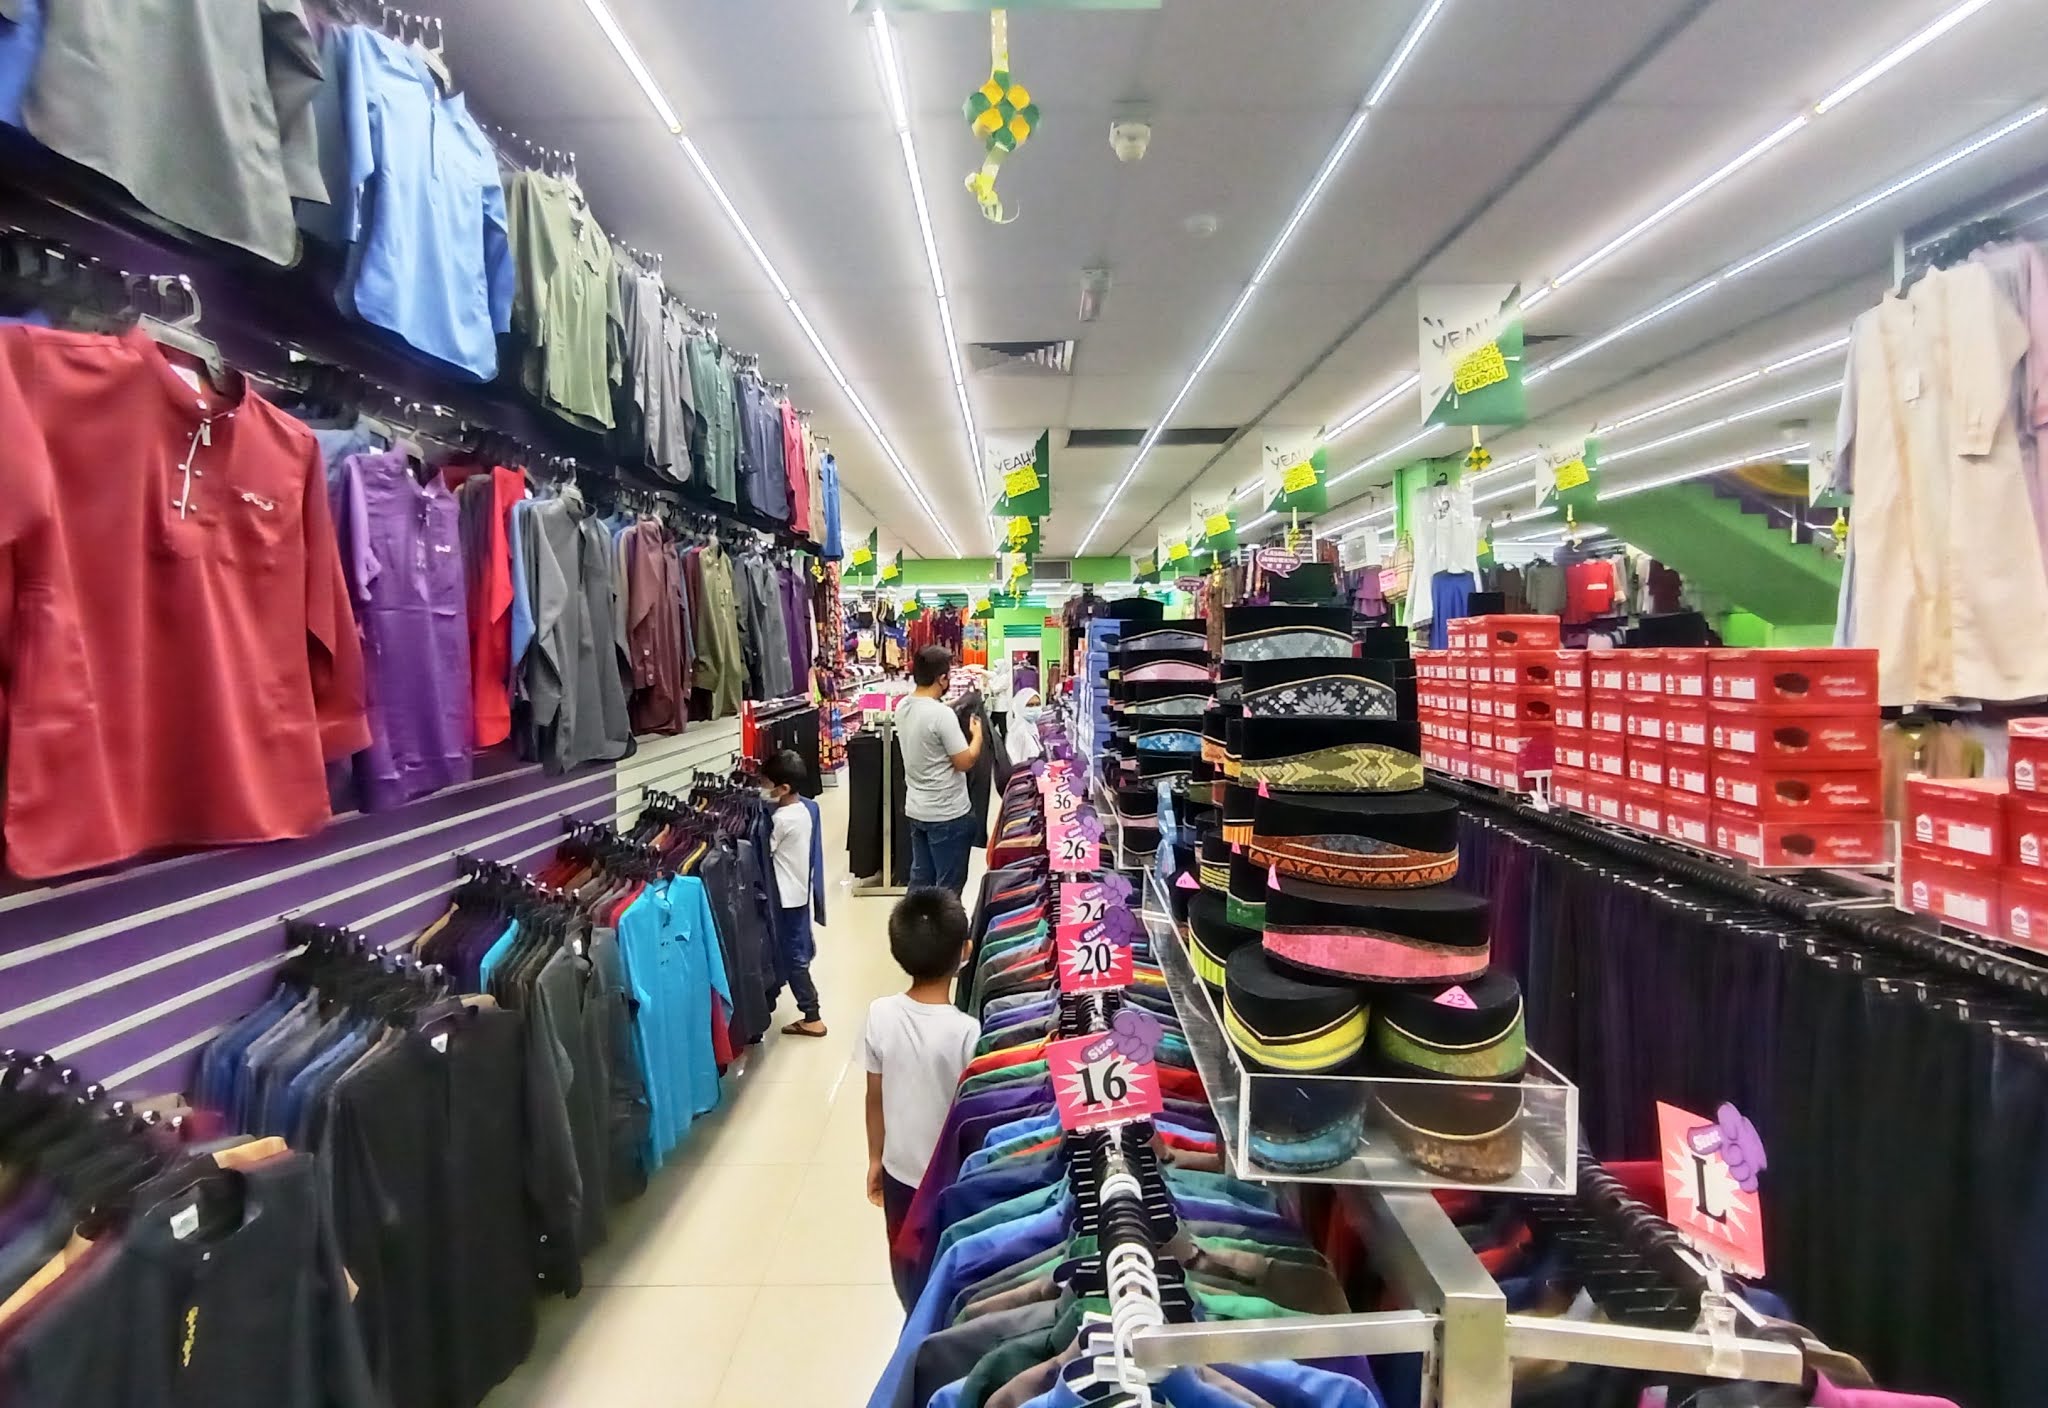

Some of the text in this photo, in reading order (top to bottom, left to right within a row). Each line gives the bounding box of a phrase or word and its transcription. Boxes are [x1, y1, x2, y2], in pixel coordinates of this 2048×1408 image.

[1053, 793, 1071, 810] 36
[1062, 839, 1086, 860] 26
[1078, 902, 1106, 923] 24
[1077, 943, 1111, 975] 20
[1446, 993, 1468, 1006] 23
[1087, 1038, 1114, 1060] Size
[1076, 1061, 1128, 1107] 16
[1692, 1154, 1727, 1225] L
